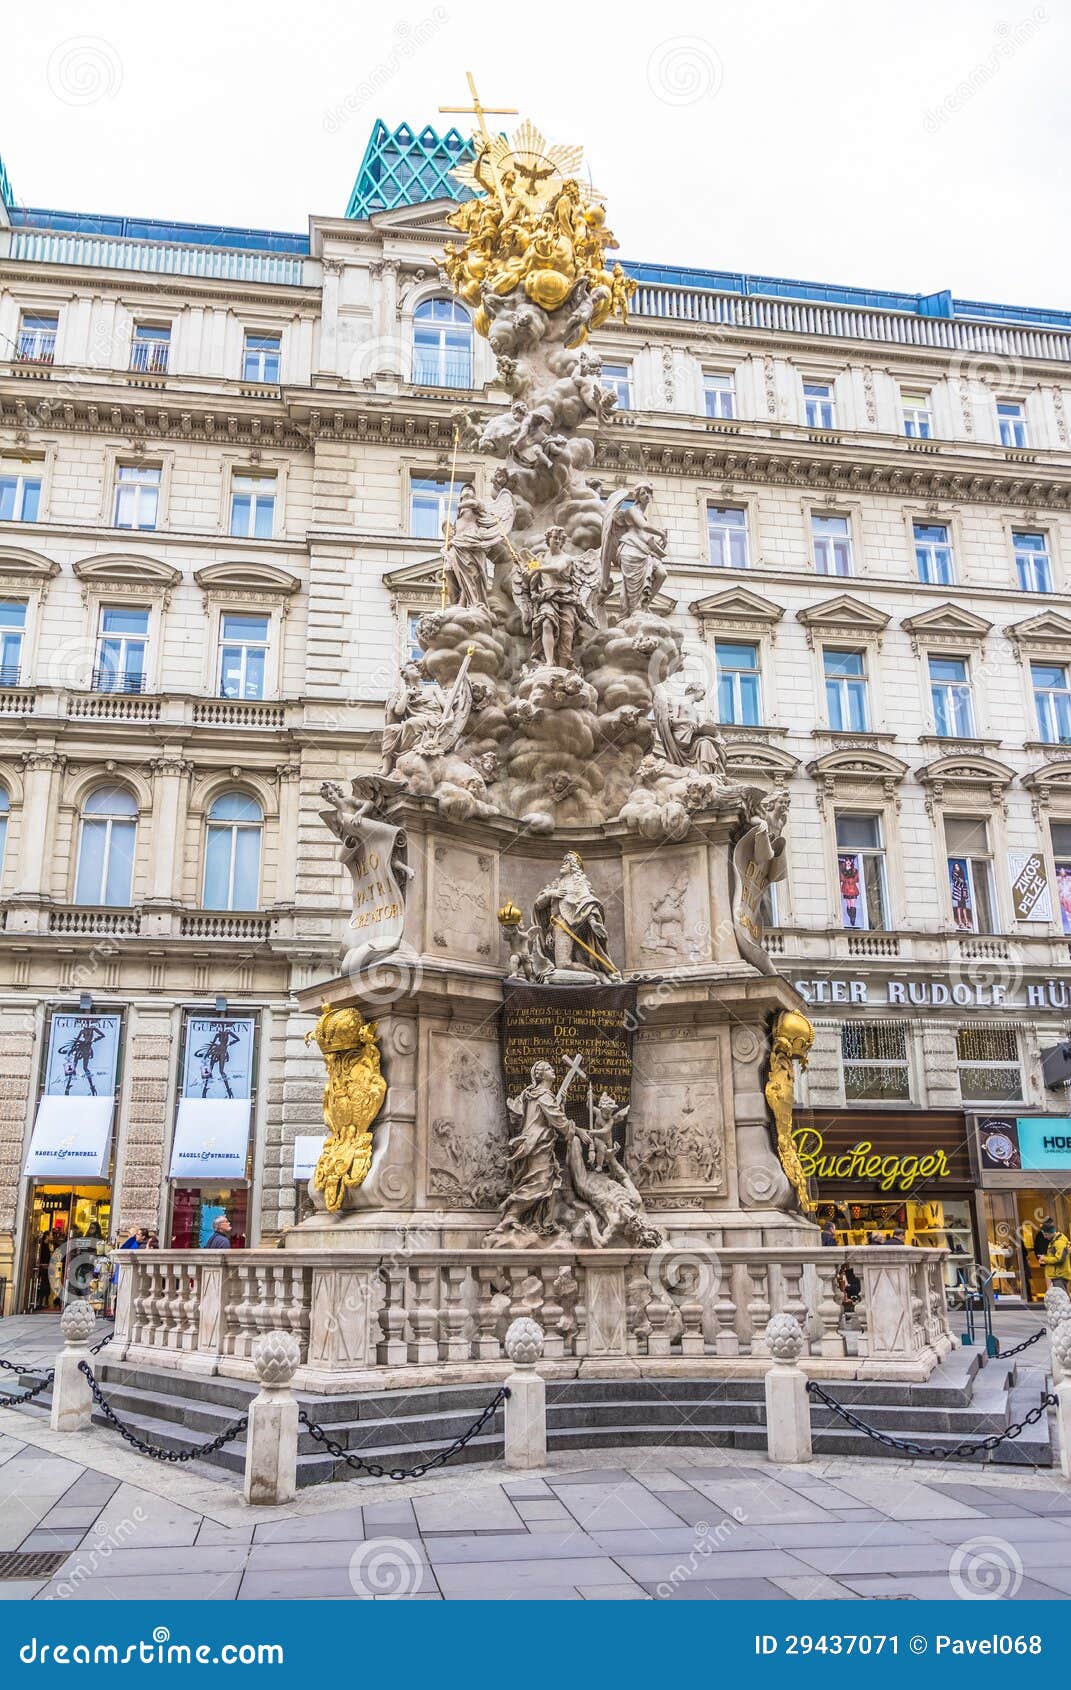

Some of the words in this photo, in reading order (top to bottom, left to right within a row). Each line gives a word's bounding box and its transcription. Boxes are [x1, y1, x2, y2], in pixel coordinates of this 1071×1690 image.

[1015, 858, 1041, 896] ZIKOS
[1018, 876, 1047, 914] PELZE
[887, 981, 1006, 1006] RUDOLF
[1027, 980, 1071, 1008] HÜ
[790, 1128, 950, 1191] Buchegger
